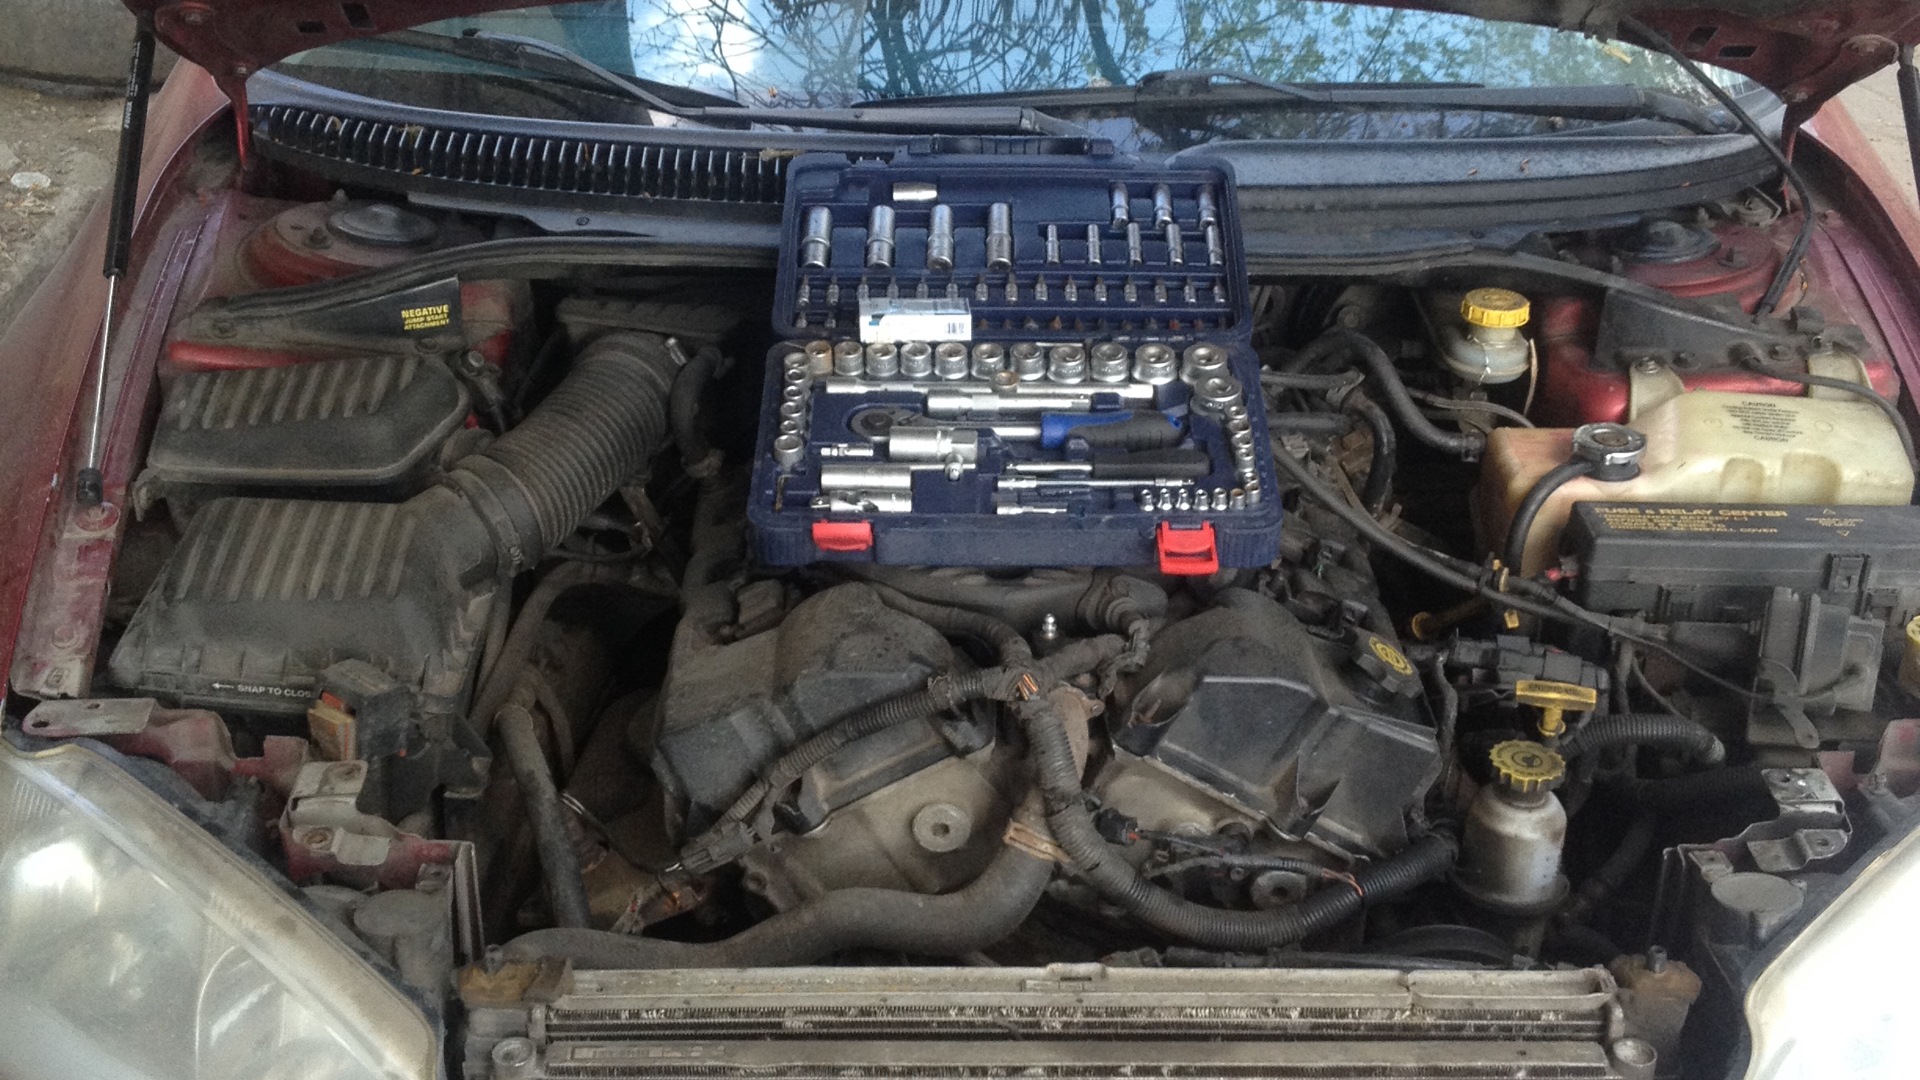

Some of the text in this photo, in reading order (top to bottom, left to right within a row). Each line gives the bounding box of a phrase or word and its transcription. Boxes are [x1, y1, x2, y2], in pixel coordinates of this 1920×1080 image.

[401, 304, 449, 318] NEGATIVE
[426, 313, 448, 321] START
[403, 318, 450, 330] ATTACHMENT
[1659, 508, 1712, 516] RELAY
[237, 684, 312, 698] SNAP TO CLOS
